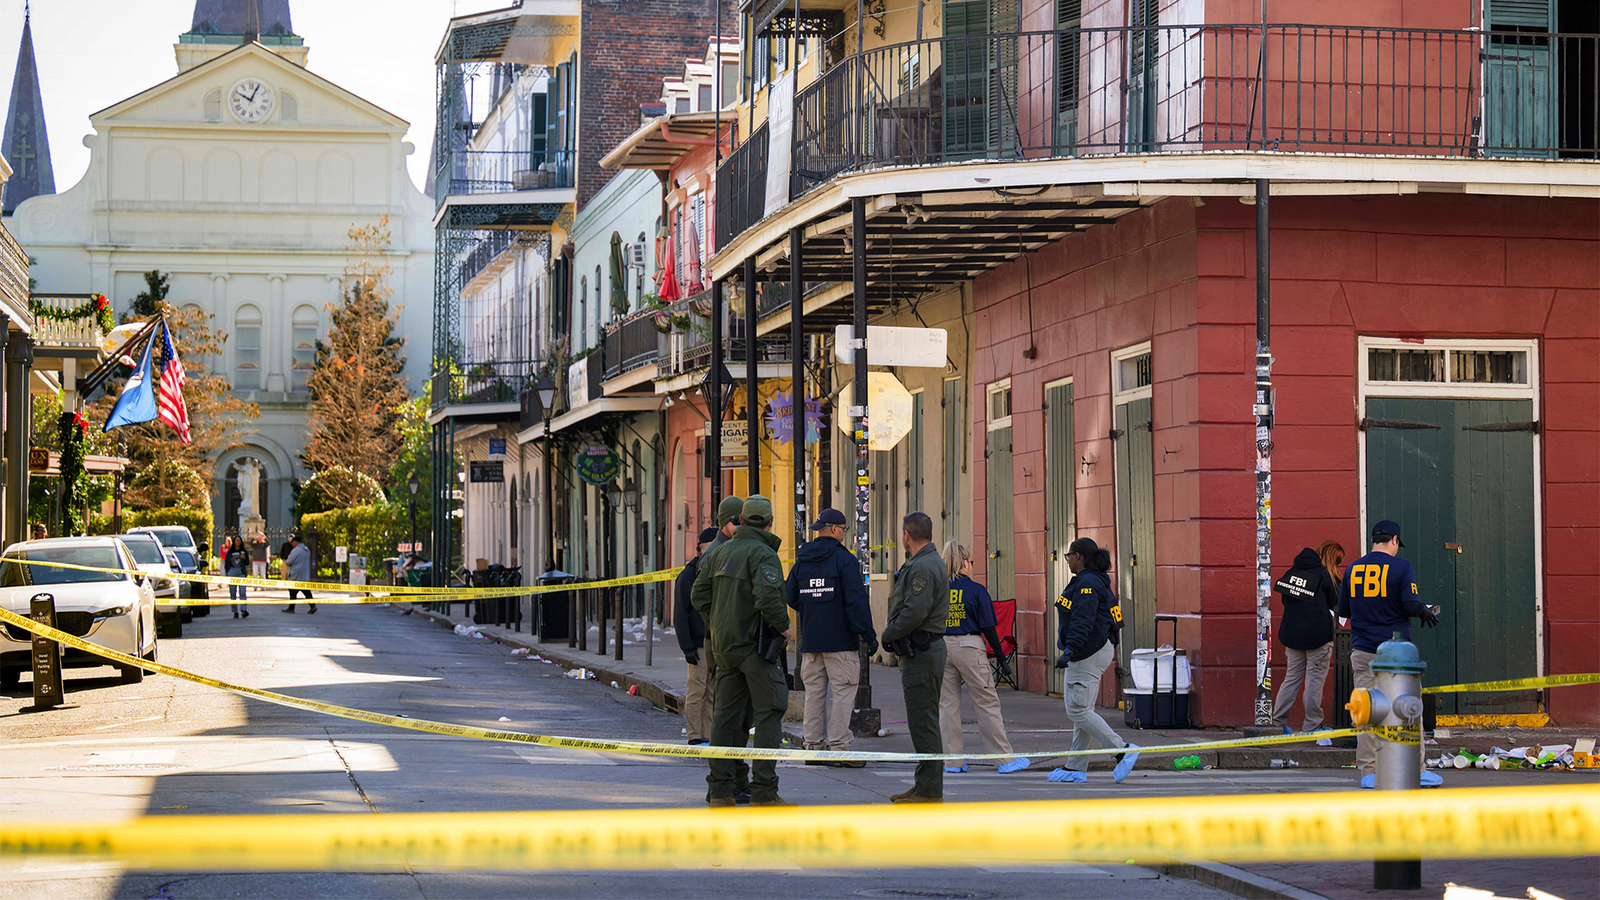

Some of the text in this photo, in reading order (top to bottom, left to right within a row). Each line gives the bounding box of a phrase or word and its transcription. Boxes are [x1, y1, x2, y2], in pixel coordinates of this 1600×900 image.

[809, 578, 825, 588] FBI
[1289, 575, 1308, 589] FBI
[1350, 564, 1390, 598] FBI
[949, 589, 963, 604] BI
[1056, 595, 1073, 610] FBI
[948, 611, 966, 620] PONSE
[1109, 605, 1123, 624] FB
[945, 619, 961, 627] TEAM
